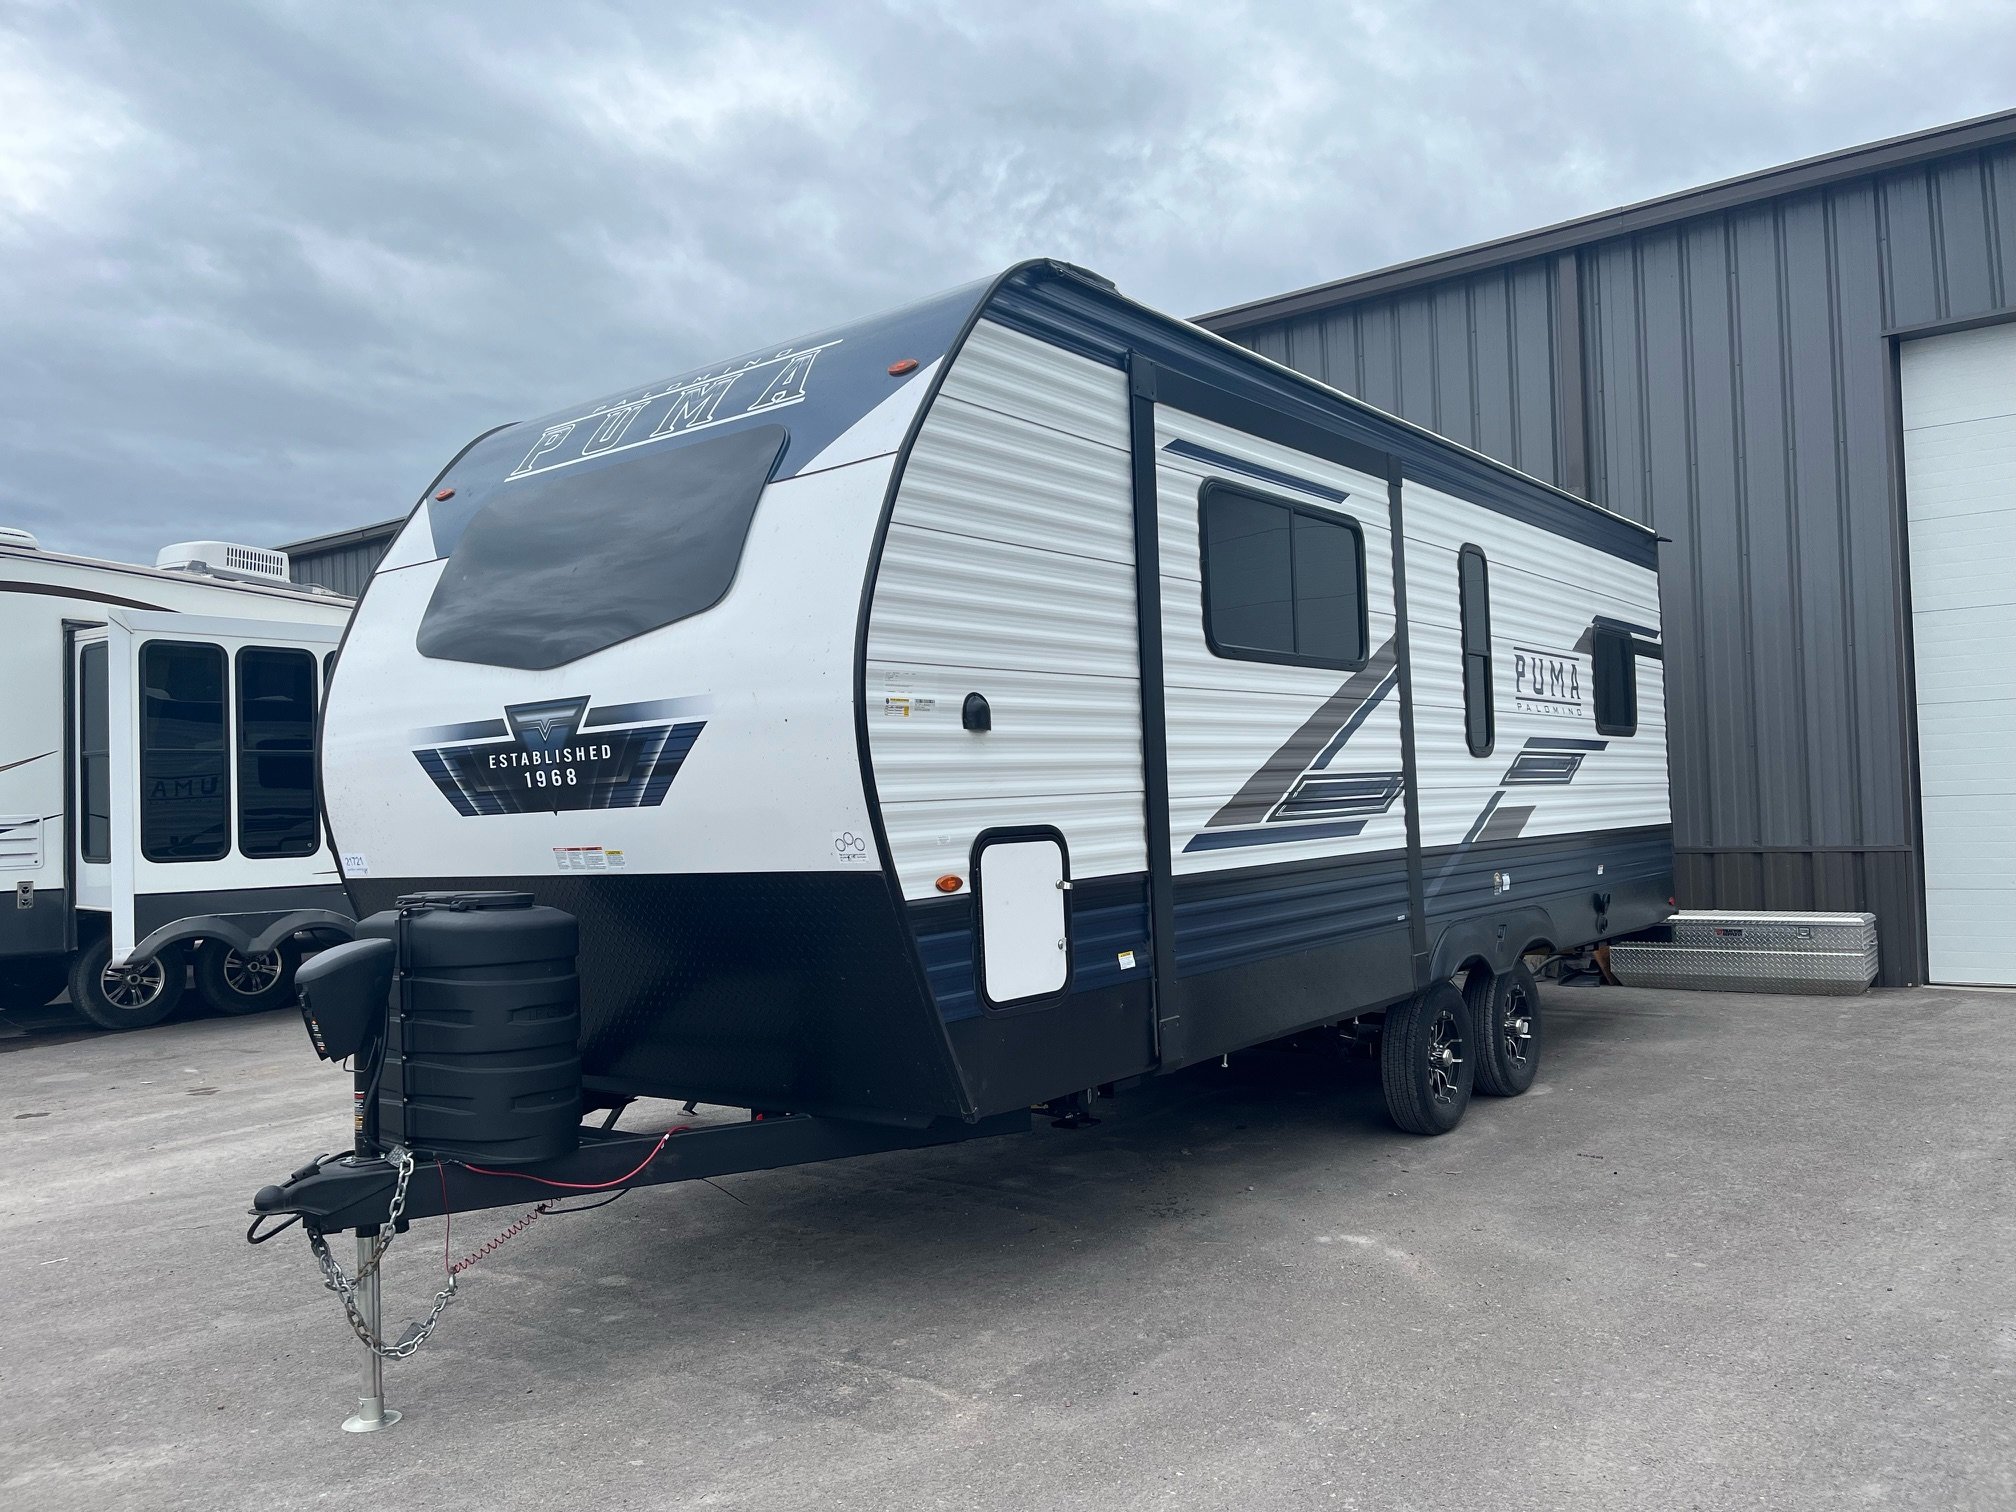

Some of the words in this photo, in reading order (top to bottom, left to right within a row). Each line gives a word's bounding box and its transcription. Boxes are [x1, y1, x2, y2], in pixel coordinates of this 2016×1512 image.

[592, 348, 793, 413] PALOMINO
[510, 349, 821, 477] PUMA
[1514, 654, 1581, 699] PUMA
[1517, 703, 1582, 716] PALOMINO
[488, 744, 612, 769] ESTABLISHED
[524, 768, 577, 788] 1968
